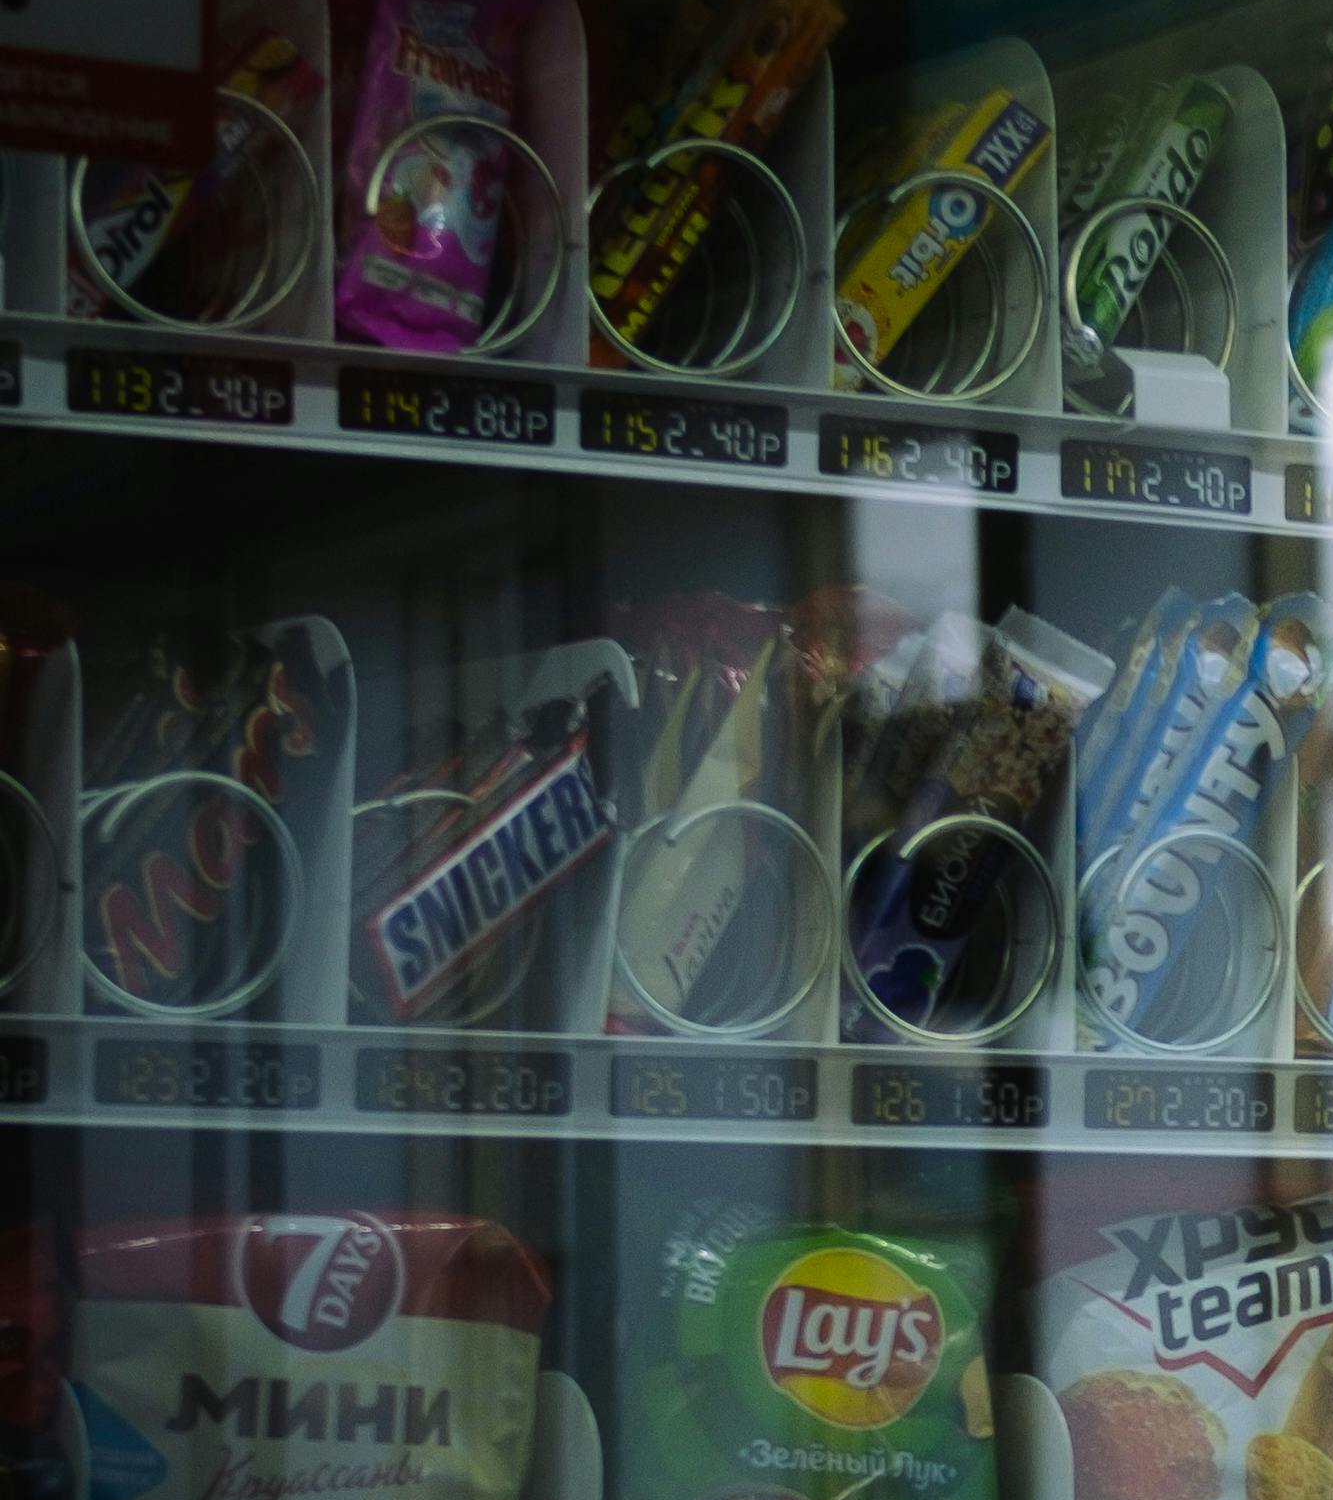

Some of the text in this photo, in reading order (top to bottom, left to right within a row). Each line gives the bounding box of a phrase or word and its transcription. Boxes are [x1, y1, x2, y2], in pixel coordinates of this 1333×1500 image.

[974, 118, 1032, 180] XXL
[620, 211, 709, 342] MELLER
[888, 189, 984, 297] Orbit
[1089, 686, 1288, 1025] BOUNTY
[262, 1214, 350, 1334] 7
[313, 1221, 386, 1331] DAYS
[1156, 1257, 1333, 1352] team
[774, 1287, 936, 1389] Lay's
[167, 1371, 451, 1447] МИНИ
